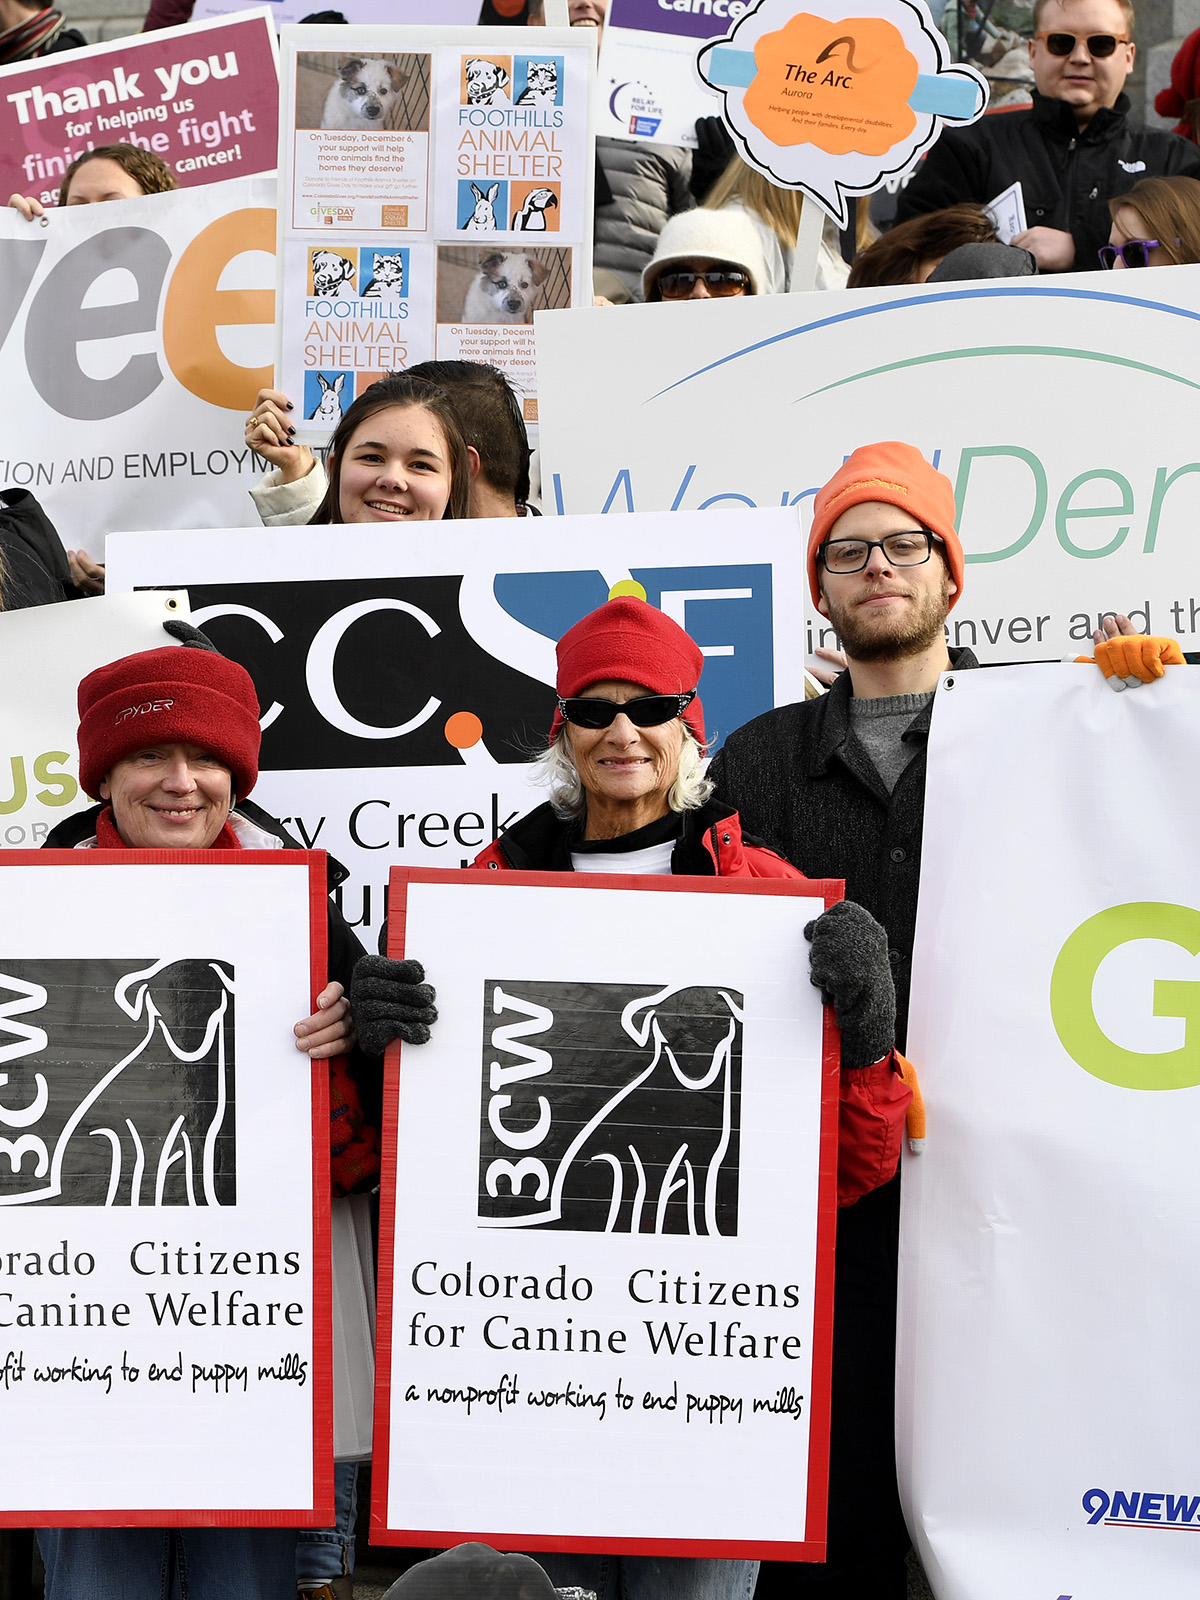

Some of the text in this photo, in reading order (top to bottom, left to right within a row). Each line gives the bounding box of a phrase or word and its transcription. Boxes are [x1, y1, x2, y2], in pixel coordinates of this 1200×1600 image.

[785, 64, 818, 84] The
[7, 51, 239, 124] Thank you
[781, 87, 813, 99] Aurora
[65, 98, 195, 139] for helping us
[459, 109, 564, 127] FOOTHILLS
[769, 105, 790, 114] Helping
[791, 108, 810, 116] people
[824, 113, 864, 124] developmental
[804, 118, 816, 126] their
[840, 124, 855, 132] Every
[21, 140, 94, 182] fini
[177, 109, 256, 149] fight
[310, 133, 322, 141] On
[324, 134, 359, 142] Tuesday,
[361, 134, 405, 142] December
[319, 144, 404, 153] your support will help
[457, 130, 563, 152] ANIMAL
[175, 144, 242, 174] cancer!
[341, 154, 373, 162] animals
[348, 164, 366, 173] they
[457, 154, 562, 177] SHELTER
[305, 301, 409, 319] FOOTHILLS
[304, 321, 408, 344] ANIMAL
[451, 327, 462, 335] On
[465, 328, 500, 336] Tuesday,
[480, 338, 511, 346] support
[304, 344, 408, 368] SHELTER
[490, 358, 507, 366] they
[61, 456, 114, 483] AND
[124, 449, 275, 479] EMPLOYM
[807, 620, 841, 654] in
[944, 614, 1051, 647] nver
[114, 699, 174, 725] SPYDER
[348, 792, 520, 850] Creek
[484, 986, 554, 1202] 3CW
[130, 1241, 301, 1276] Citizens
[411, 1261, 800, 1308] Colorado Citizens
[146, 1291, 303, 1327] Welfare
[408, 1312, 801, 1361] for Canine Welfare
[33, 1356, 113, 1394] working
[121, 1350, 140, 1382] to
[148, 1351, 183, 1382] end
[191, 1363, 248, 1393] puppy
[258, 1353, 308, 1387] mills
[405, 1374, 803, 1424] a nonprofit working to end puppy mills
[1082, 1488, 1200, 1525] 9NEW
